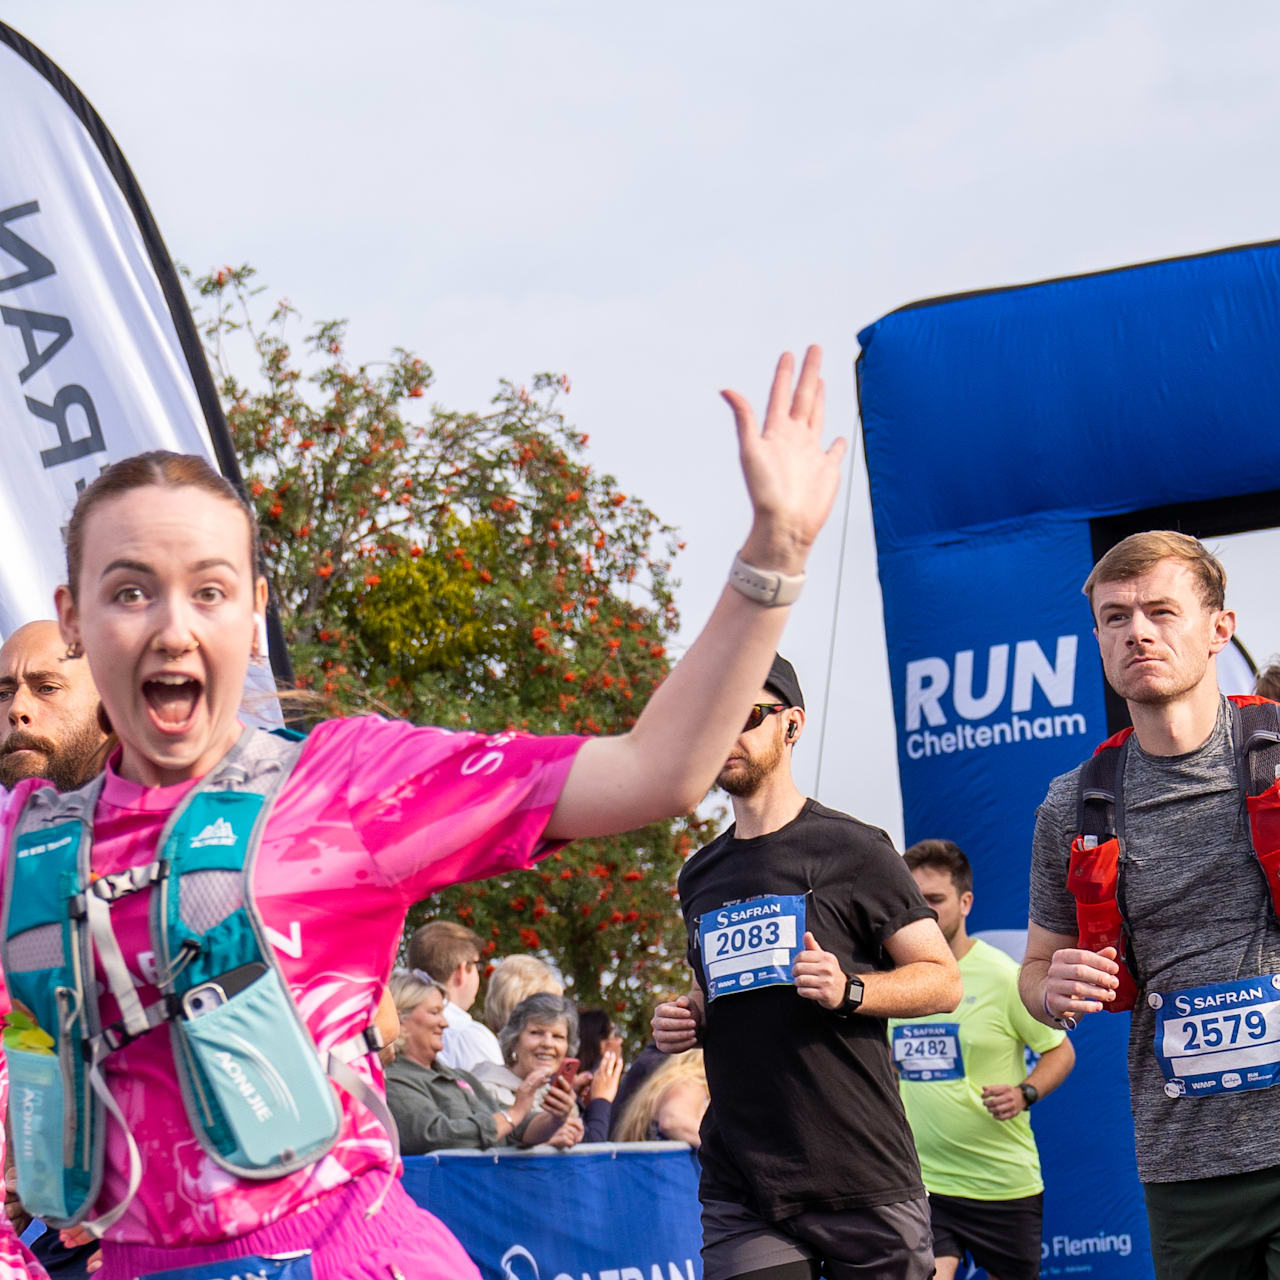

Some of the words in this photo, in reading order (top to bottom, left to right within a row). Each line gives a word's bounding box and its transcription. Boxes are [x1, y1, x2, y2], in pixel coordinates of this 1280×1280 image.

[905, 635, 1079, 731] RUN
[907, 713, 1086, 759] Cheltenham
[730, 903, 781, 922] SAFRAN
[716, 922, 780, 957] 2083
[1194, 987, 1263, 1010] SAFRAN
[1182, 1010, 1267, 1051] 2579
[904, 1040, 948, 1057] 2482
[1052, 1231, 1132, 1256] Fleming
